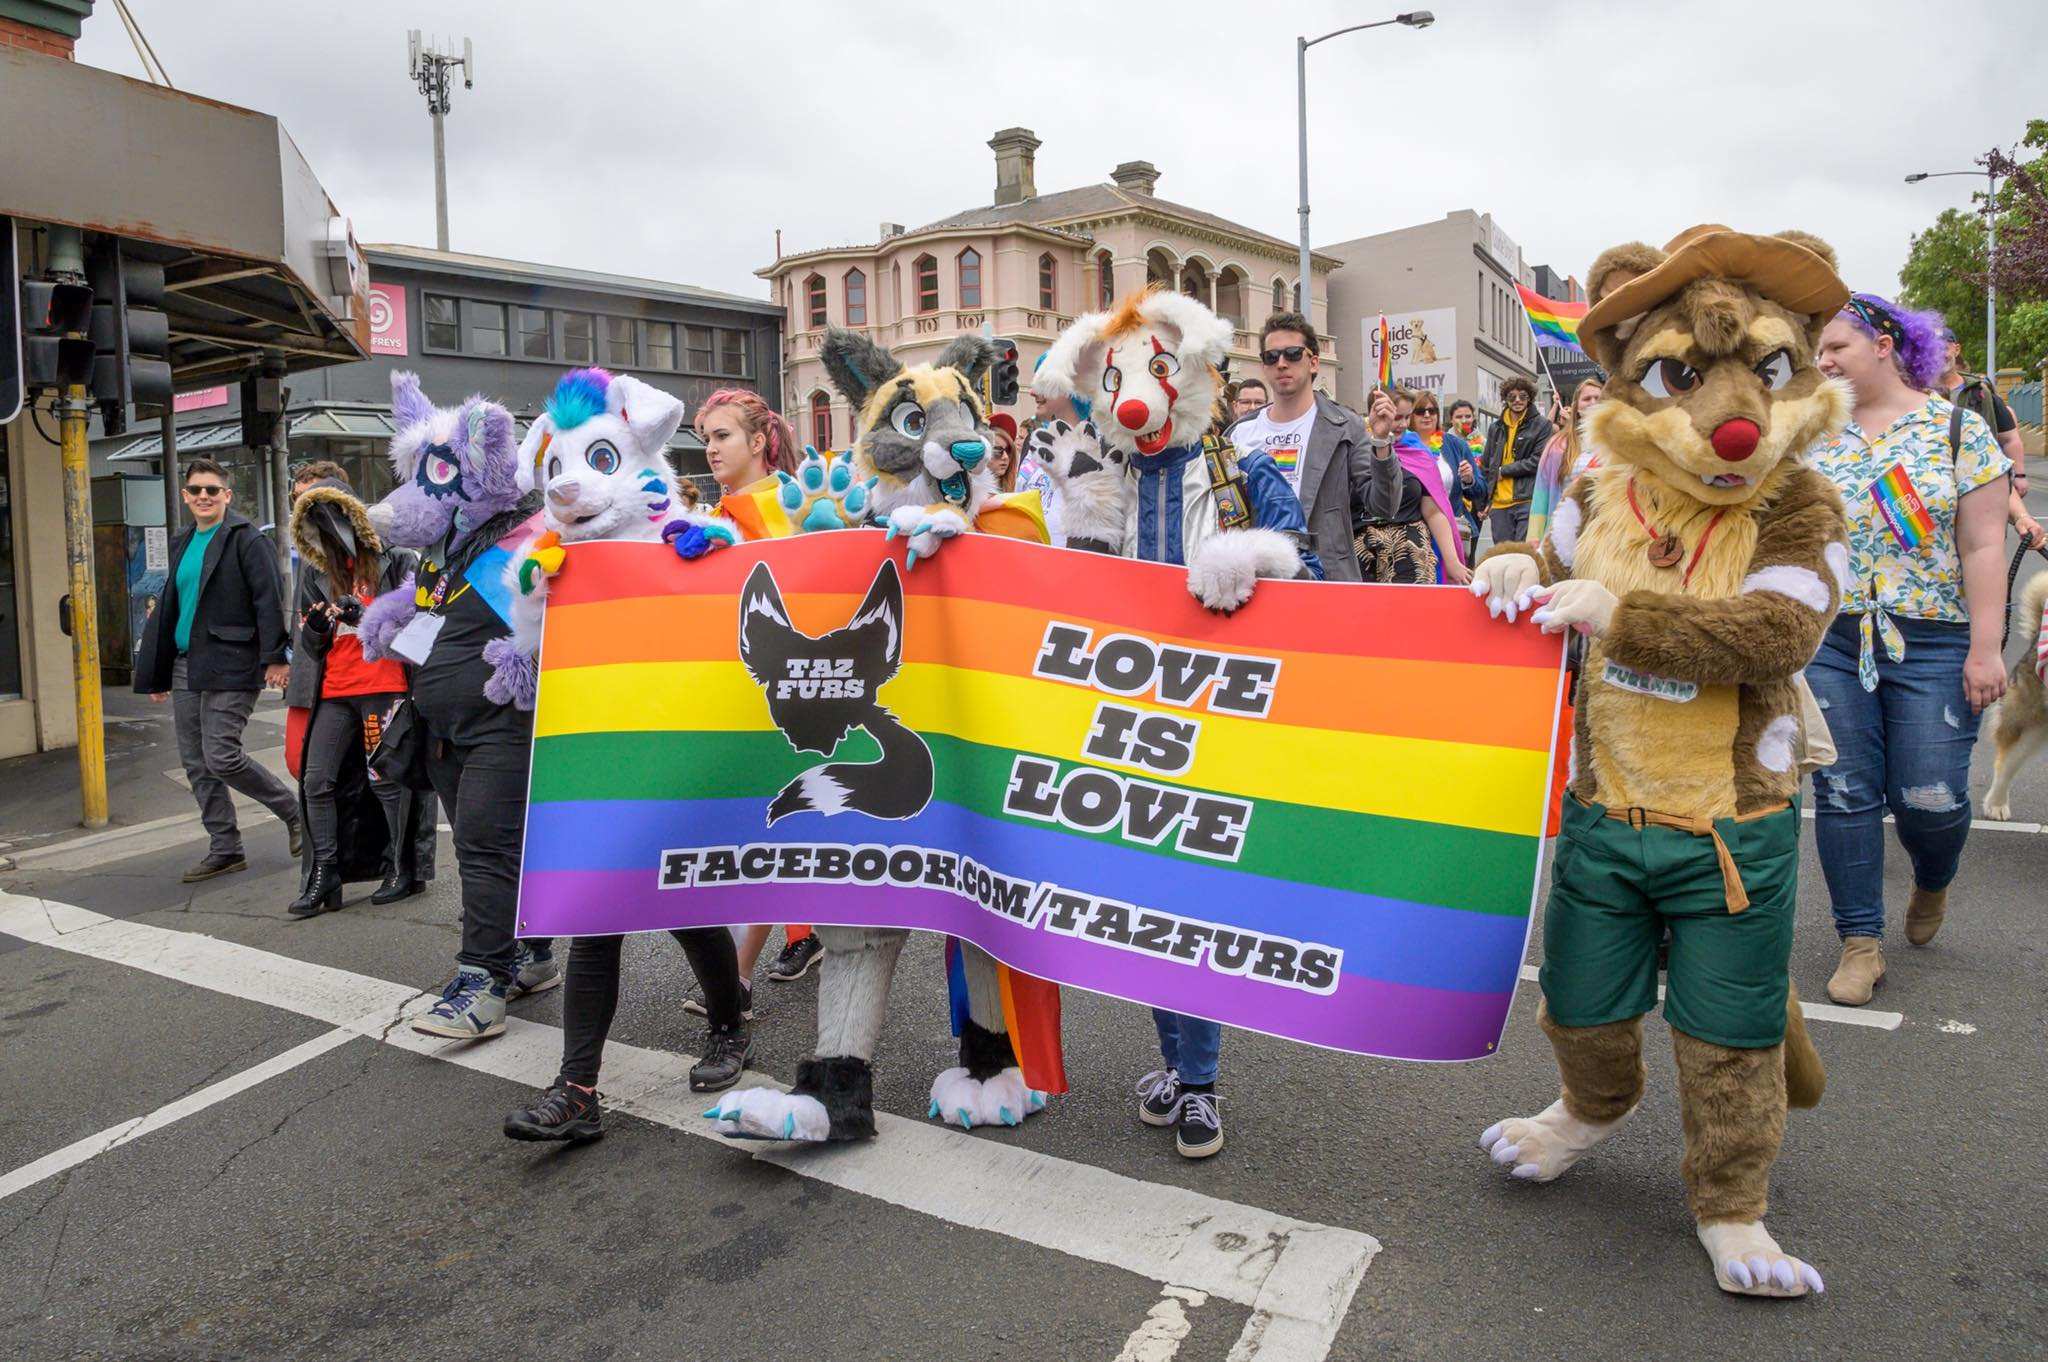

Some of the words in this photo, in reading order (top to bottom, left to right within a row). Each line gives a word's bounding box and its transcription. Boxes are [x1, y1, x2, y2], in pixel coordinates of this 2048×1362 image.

[371, 337, 401, 348] FREYS
[1371, 343, 1408, 360] Dgs
[776, 679, 865, 700] FURS
[786, 659, 854, 678] TAZ
[1038, 626, 1277, 713] LOVE
[1086, 706, 1197, 771] IS
[1007, 760, 1248, 856] LOVE
[662, 848, 1341, 988] FACEBOOK.COM/TAZFURS
